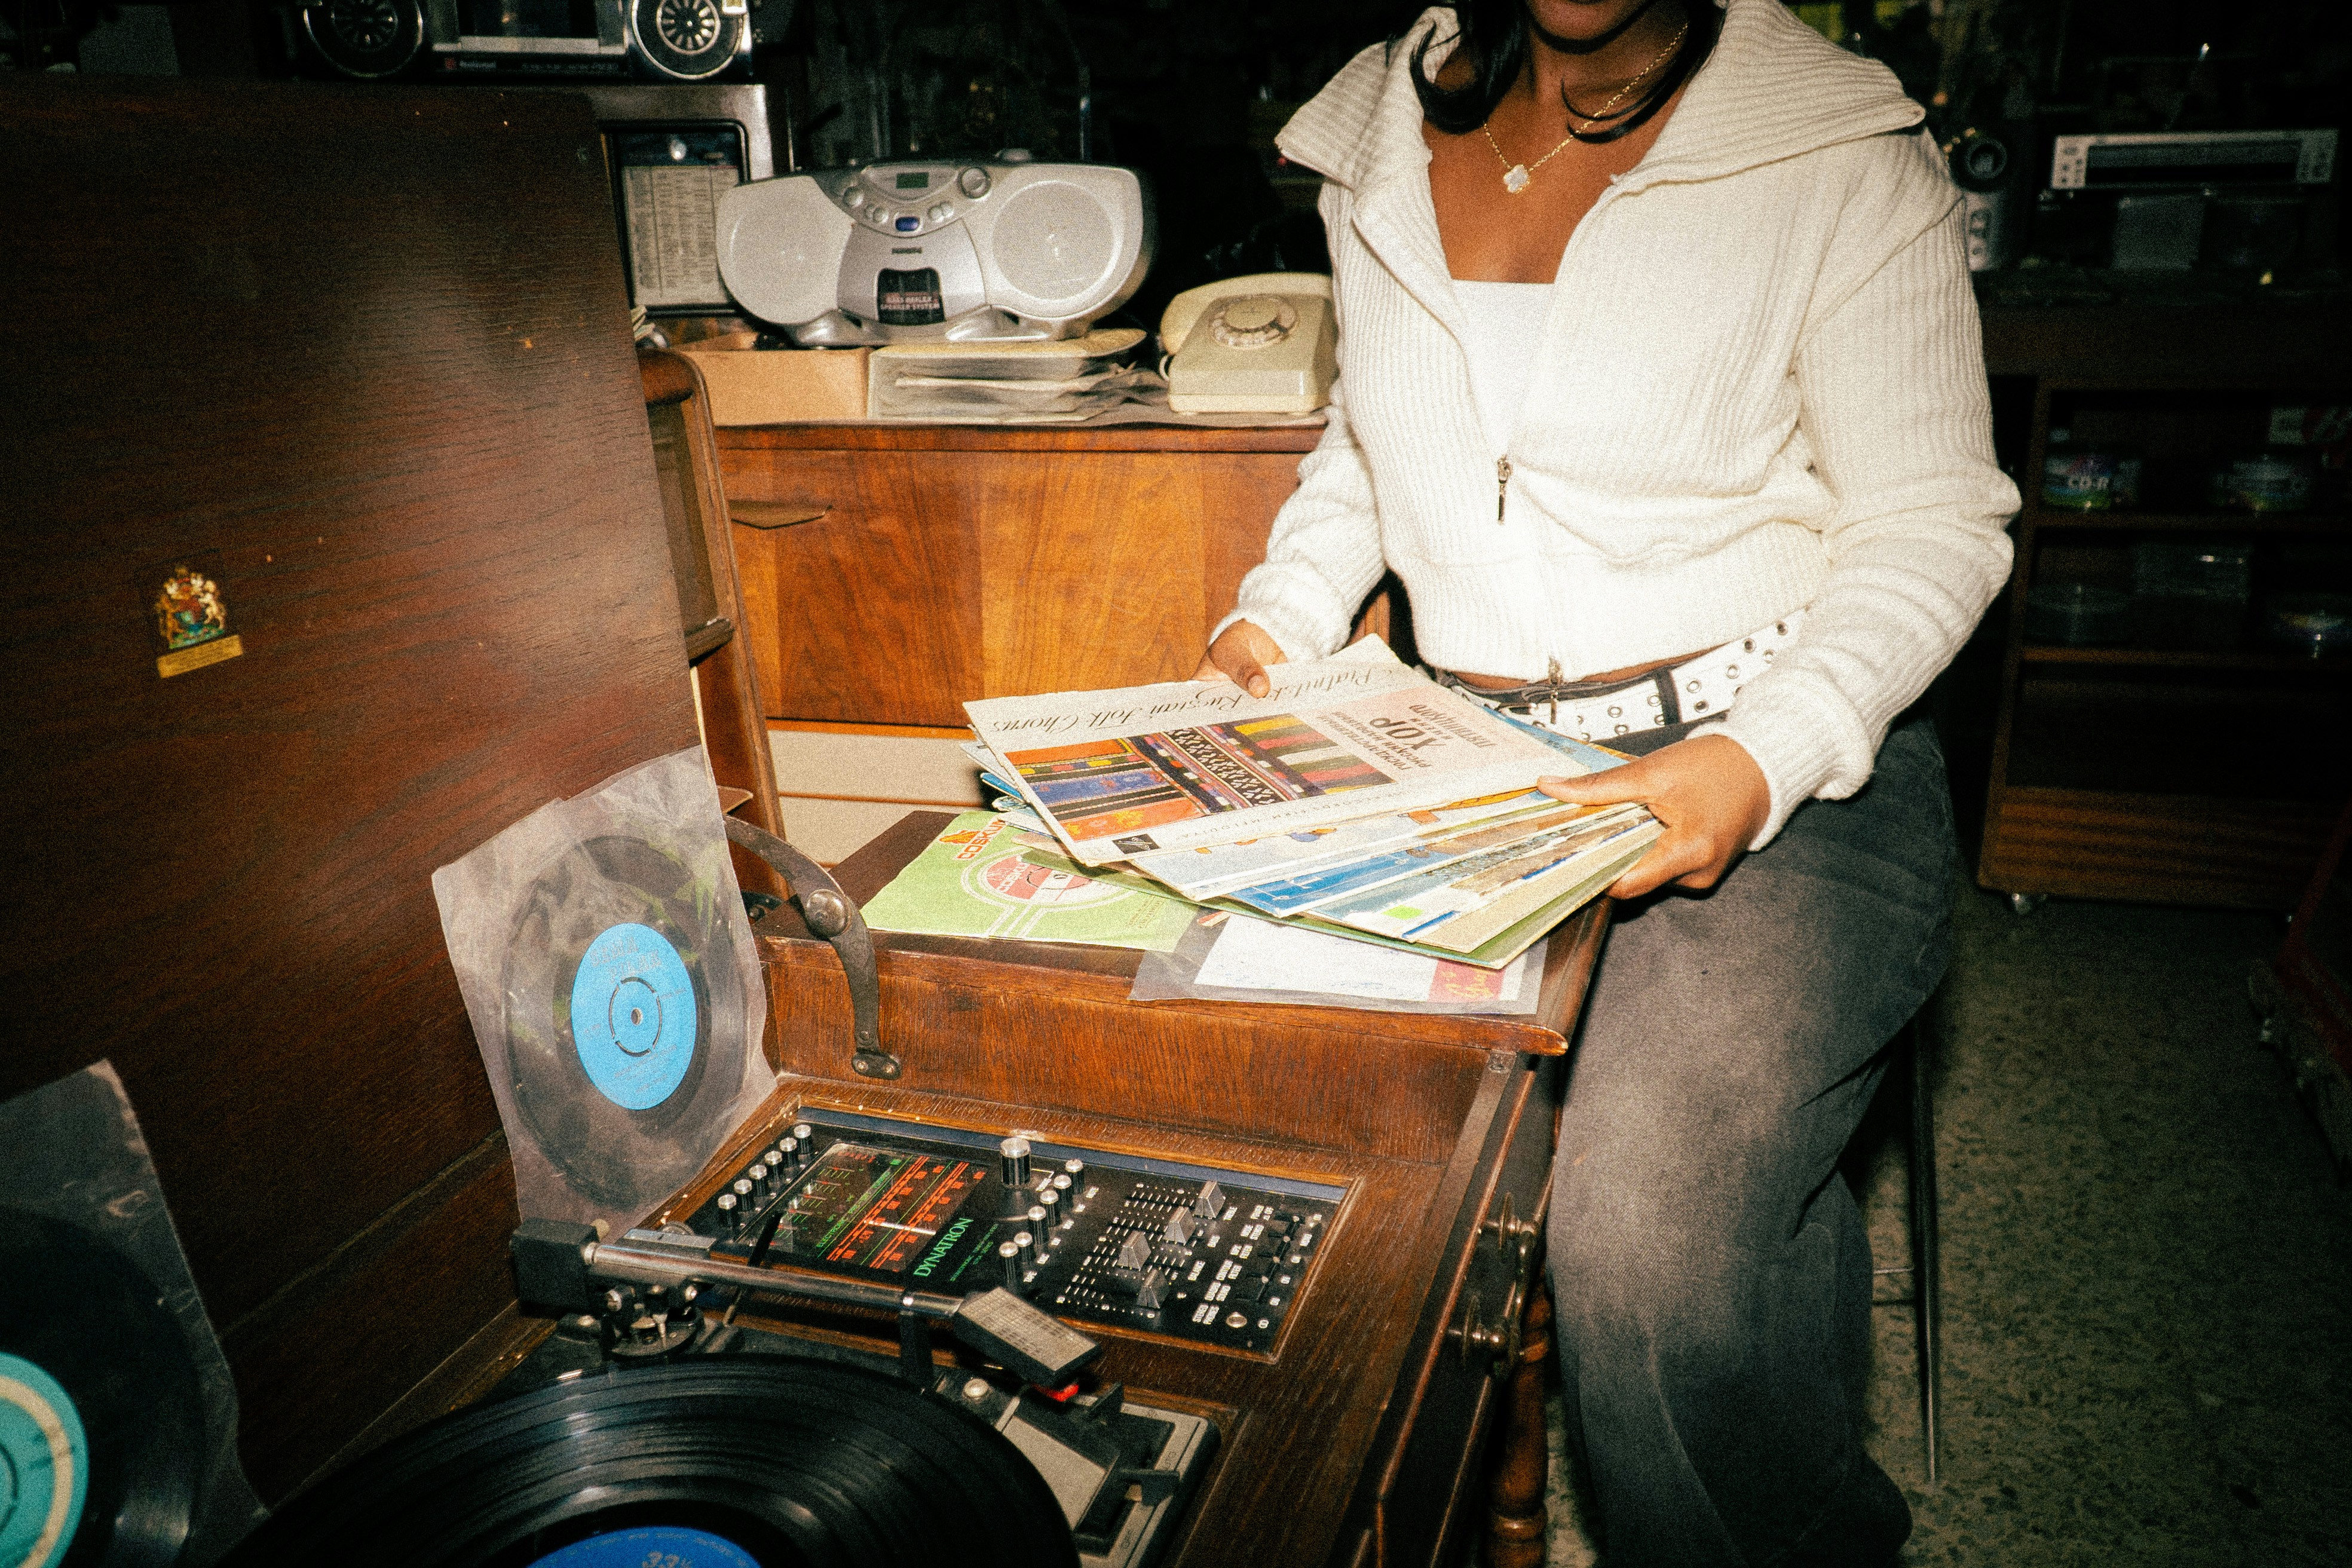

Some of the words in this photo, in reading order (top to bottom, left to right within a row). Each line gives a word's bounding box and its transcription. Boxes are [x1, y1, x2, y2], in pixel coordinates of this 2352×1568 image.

[2067, 474, 2109, 490] CD-R
[993, 712, 1080, 733] Chorus
[1370, 717, 1446, 751] ХОР
[912, 1217, 974, 1277] DYNATRON
[1188, 1261, 1205, 1281] BALANCE
